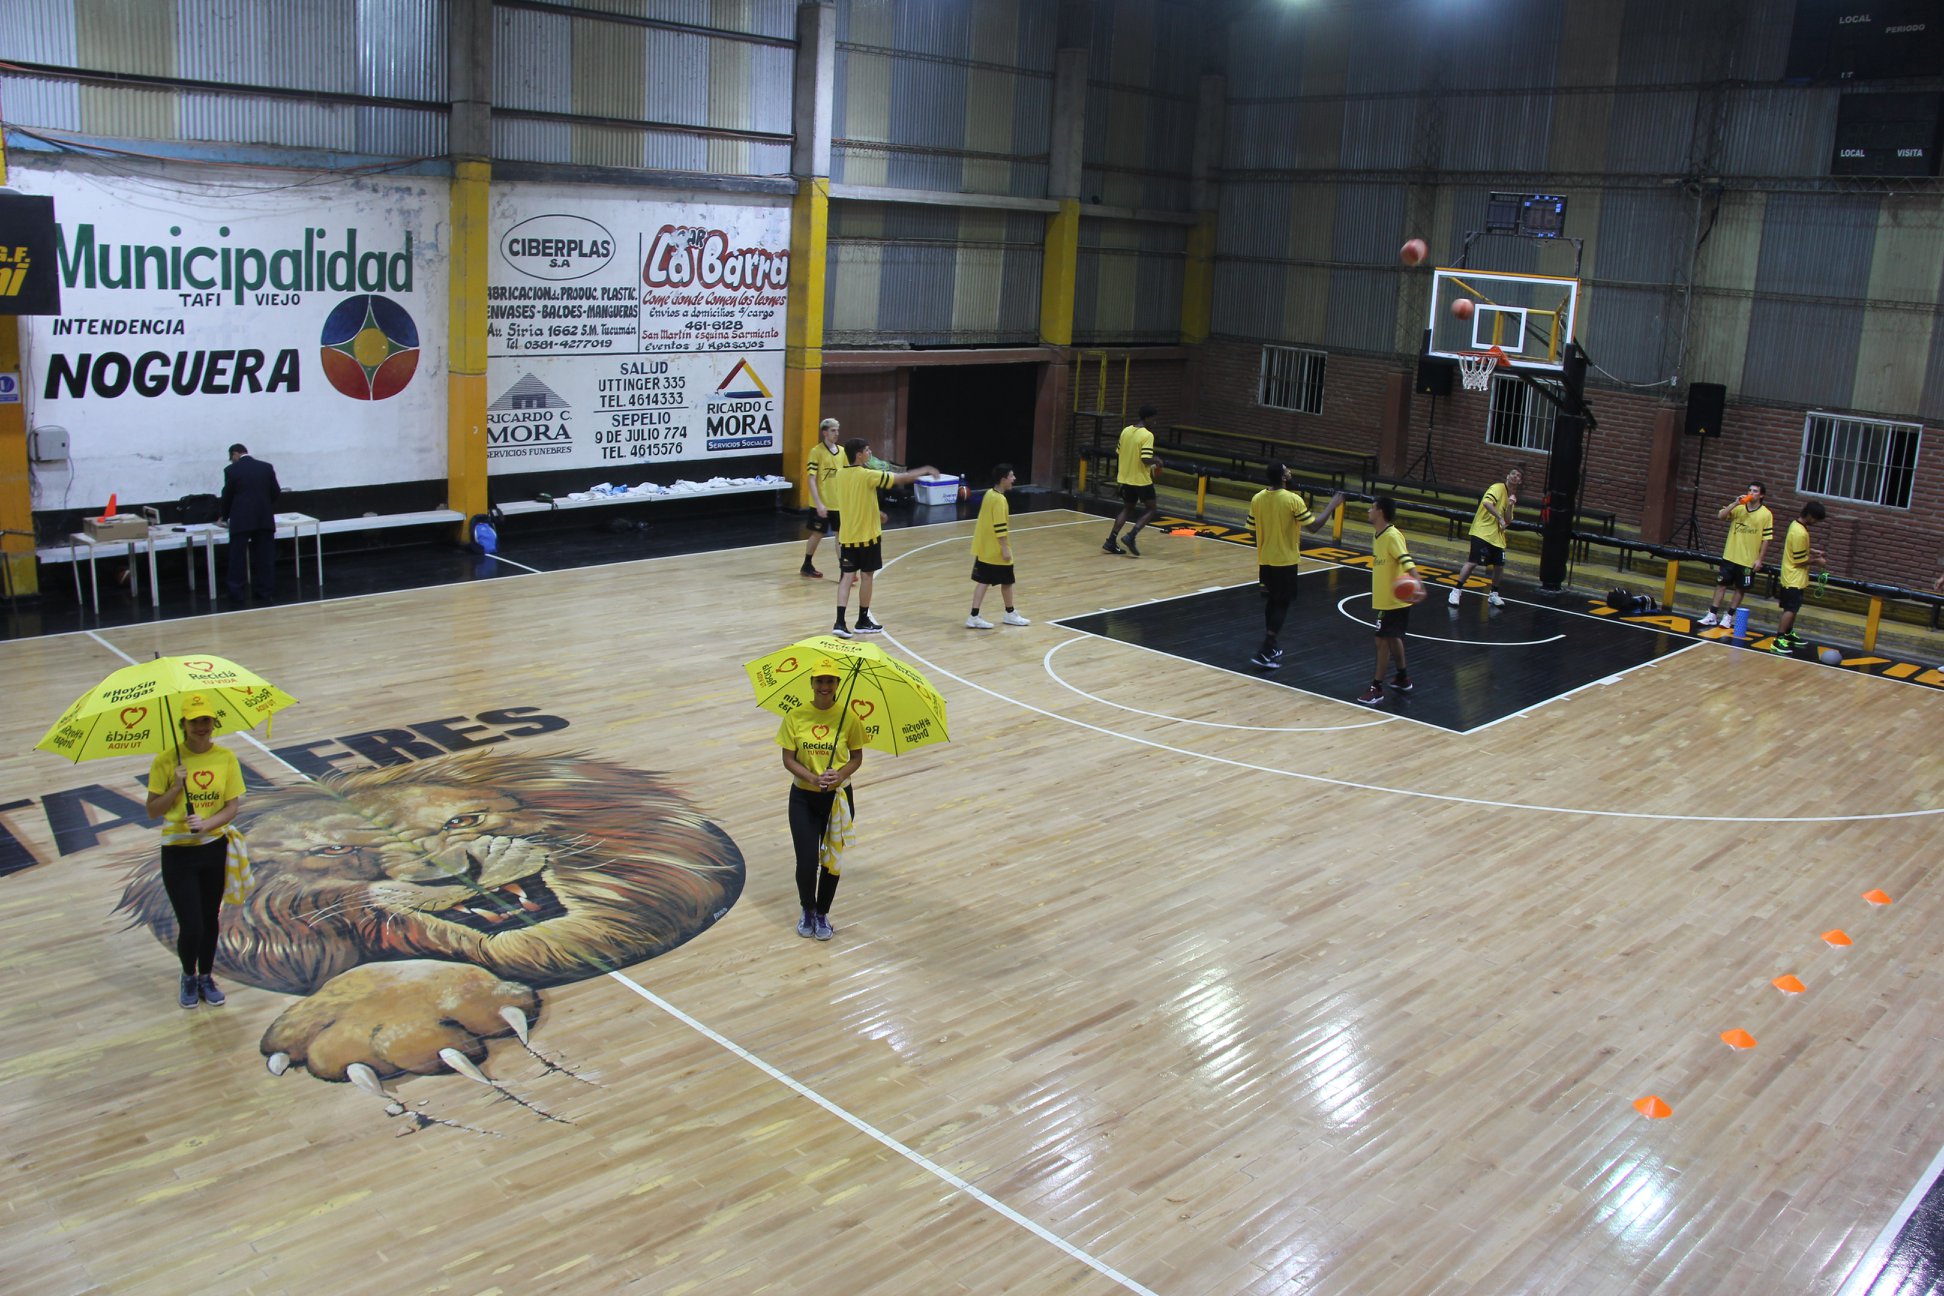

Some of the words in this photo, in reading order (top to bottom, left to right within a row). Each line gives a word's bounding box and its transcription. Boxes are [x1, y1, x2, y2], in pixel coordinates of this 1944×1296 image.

[1839, 14, 1872, 24] LOCAL
[1885, 24, 1926, 33] PERIODO
[1840, 149, 1865, 157] LOCAL
[1897, 148, 1923, 157] VISITA
[508, 238, 611, 258] CIBERPLAS
[55, 223, 414, 305] Municipalidad
[644, 225, 693, 288] La
[697, 229, 788, 291] Barra
[179, 293, 221, 307] TAFI
[255, 293, 301, 306] VIEJO
[682, 309, 689, 317] a
[53, 318, 185, 335] INTENDENCIA
[507, 322, 544, 337] Siria
[547, 325, 578, 337] 1662
[580, 324, 599, 336] S.M.
[600, 323, 637, 336] Tucumán
[684, 320, 744, 331] 461-6128
[642, 329, 659, 340] San
[694, 329, 730, 341] esquina
[731, 326, 779, 339] Sarmiento
[524, 338, 613, 350] 0381-4277019
[645, 340, 690, 351] Eventos
[44, 348, 301, 400] NOGUERA
[620, 361, 669, 376] SALUD
[598, 377, 660, 392] UTTINGER
[663, 376, 686, 389] 335
[600, 394, 627, 408] TEL.
[628, 392, 684, 407] 4614333
[707, 401, 761, 415] RICARDO
[765, 400, 774, 411] C
[487, 411, 553, 424] RICARDO
[560, 410, 573, 421] C.
[611, 411, 671, 428] SEPELIO
[706, 413, 773, 438] MORA
[487, 423, 572, 444] MORA
[594, 431, 603, 445] 9
[606, 430, 622, 443] DE
[624, 427, 660, 442] JULIO
[663, 426, 688, 440] 774
[528, 446, 573, 456] FUNEBRES
[602, 446, 627, 459] TEL.
[630, 442, 683, 457] 4615576
[188, 670, 237, 680] Reciclá
[103, 681, 156, 698] #HoySin
[111, 687, 155, 703] Drogas
[803, 741, 833, 750] Reciclá
[187, 791, 220, 801] Reciclá
